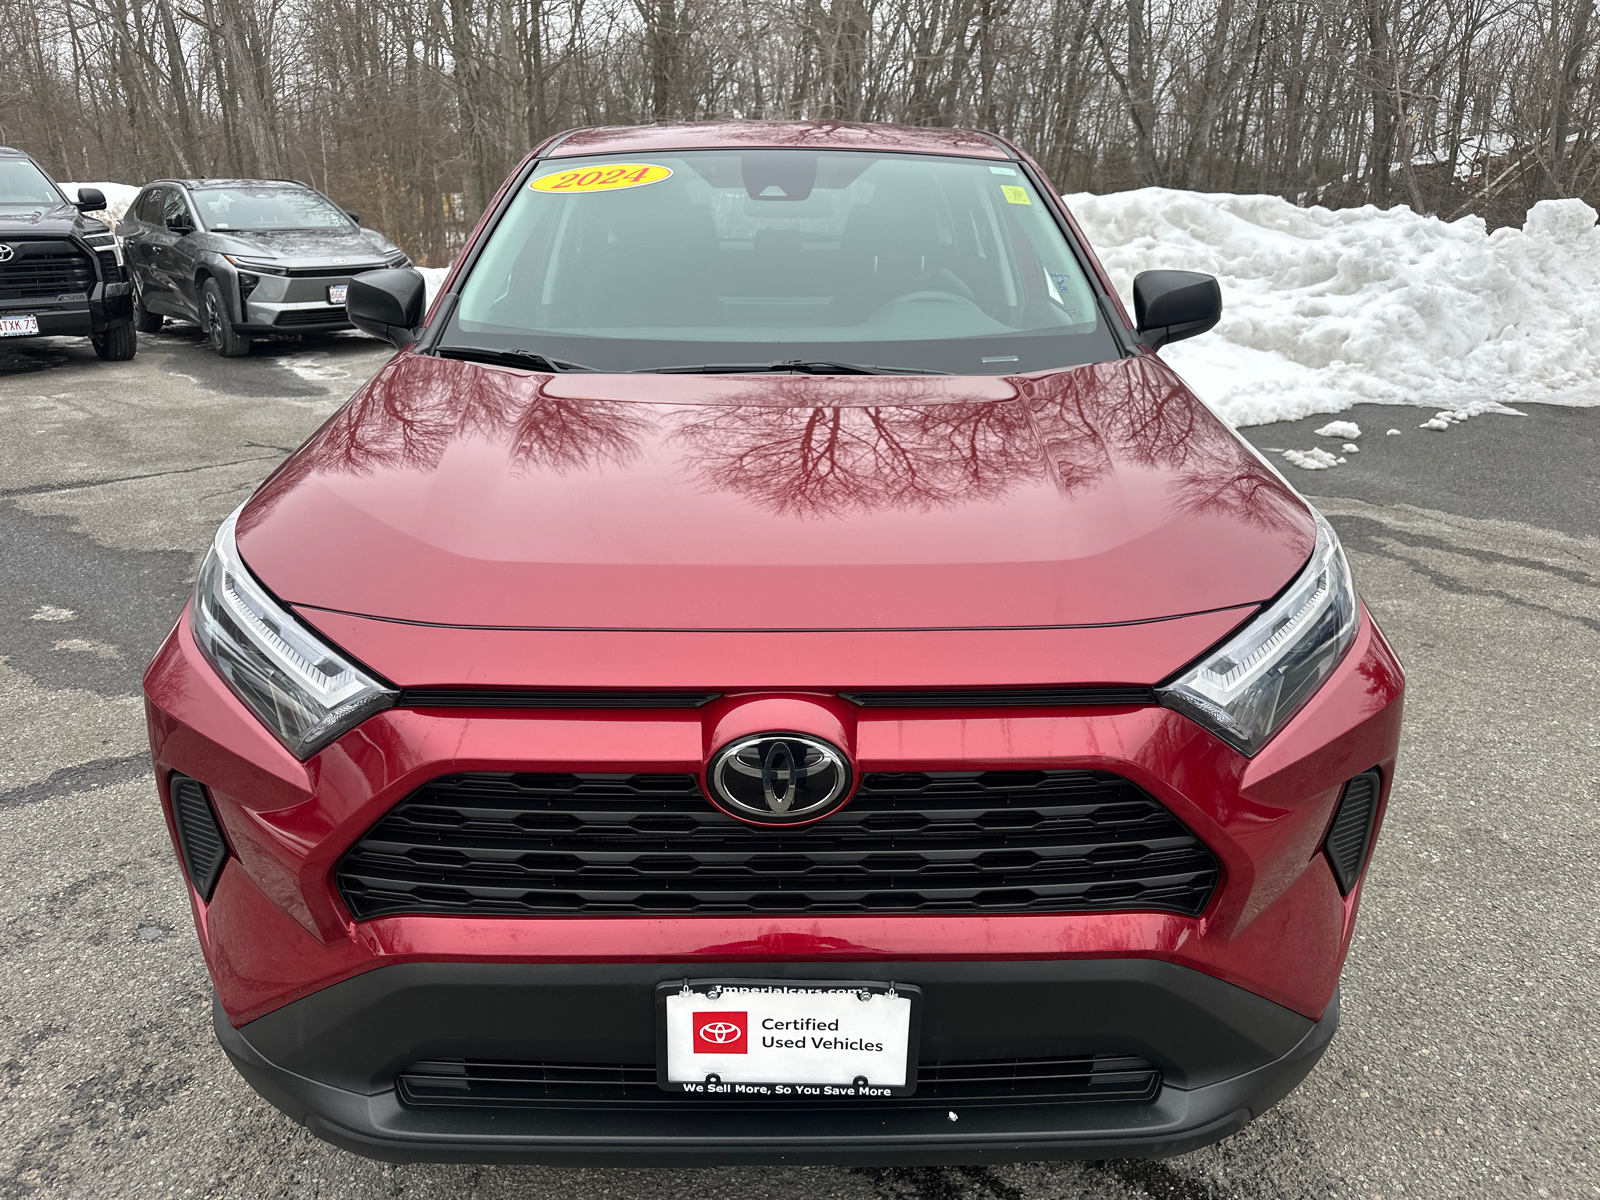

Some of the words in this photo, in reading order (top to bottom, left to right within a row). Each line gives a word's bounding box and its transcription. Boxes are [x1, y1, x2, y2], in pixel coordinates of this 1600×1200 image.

[550, 167, 651, 190] 2024
[24, 319, 37, 330] 73
[715, 985, 863, 995] Imperialcars.com
[761, 1018, 839, 1032] Certified
[762, 1036, 806, 1049] Used
[811, 1037, 884, 1052] Vehicles
[683, 1083, 704, 1093] We
[707, 1083, 731, 1093] Sell
[735, 1085, 771, 1095] More,
[775, 1085, 792, 1095] So
[795, 1085, 820, 1095] You
[823, 1086, 855, 1096] Save
[858, 1087, 891, 1096] More
